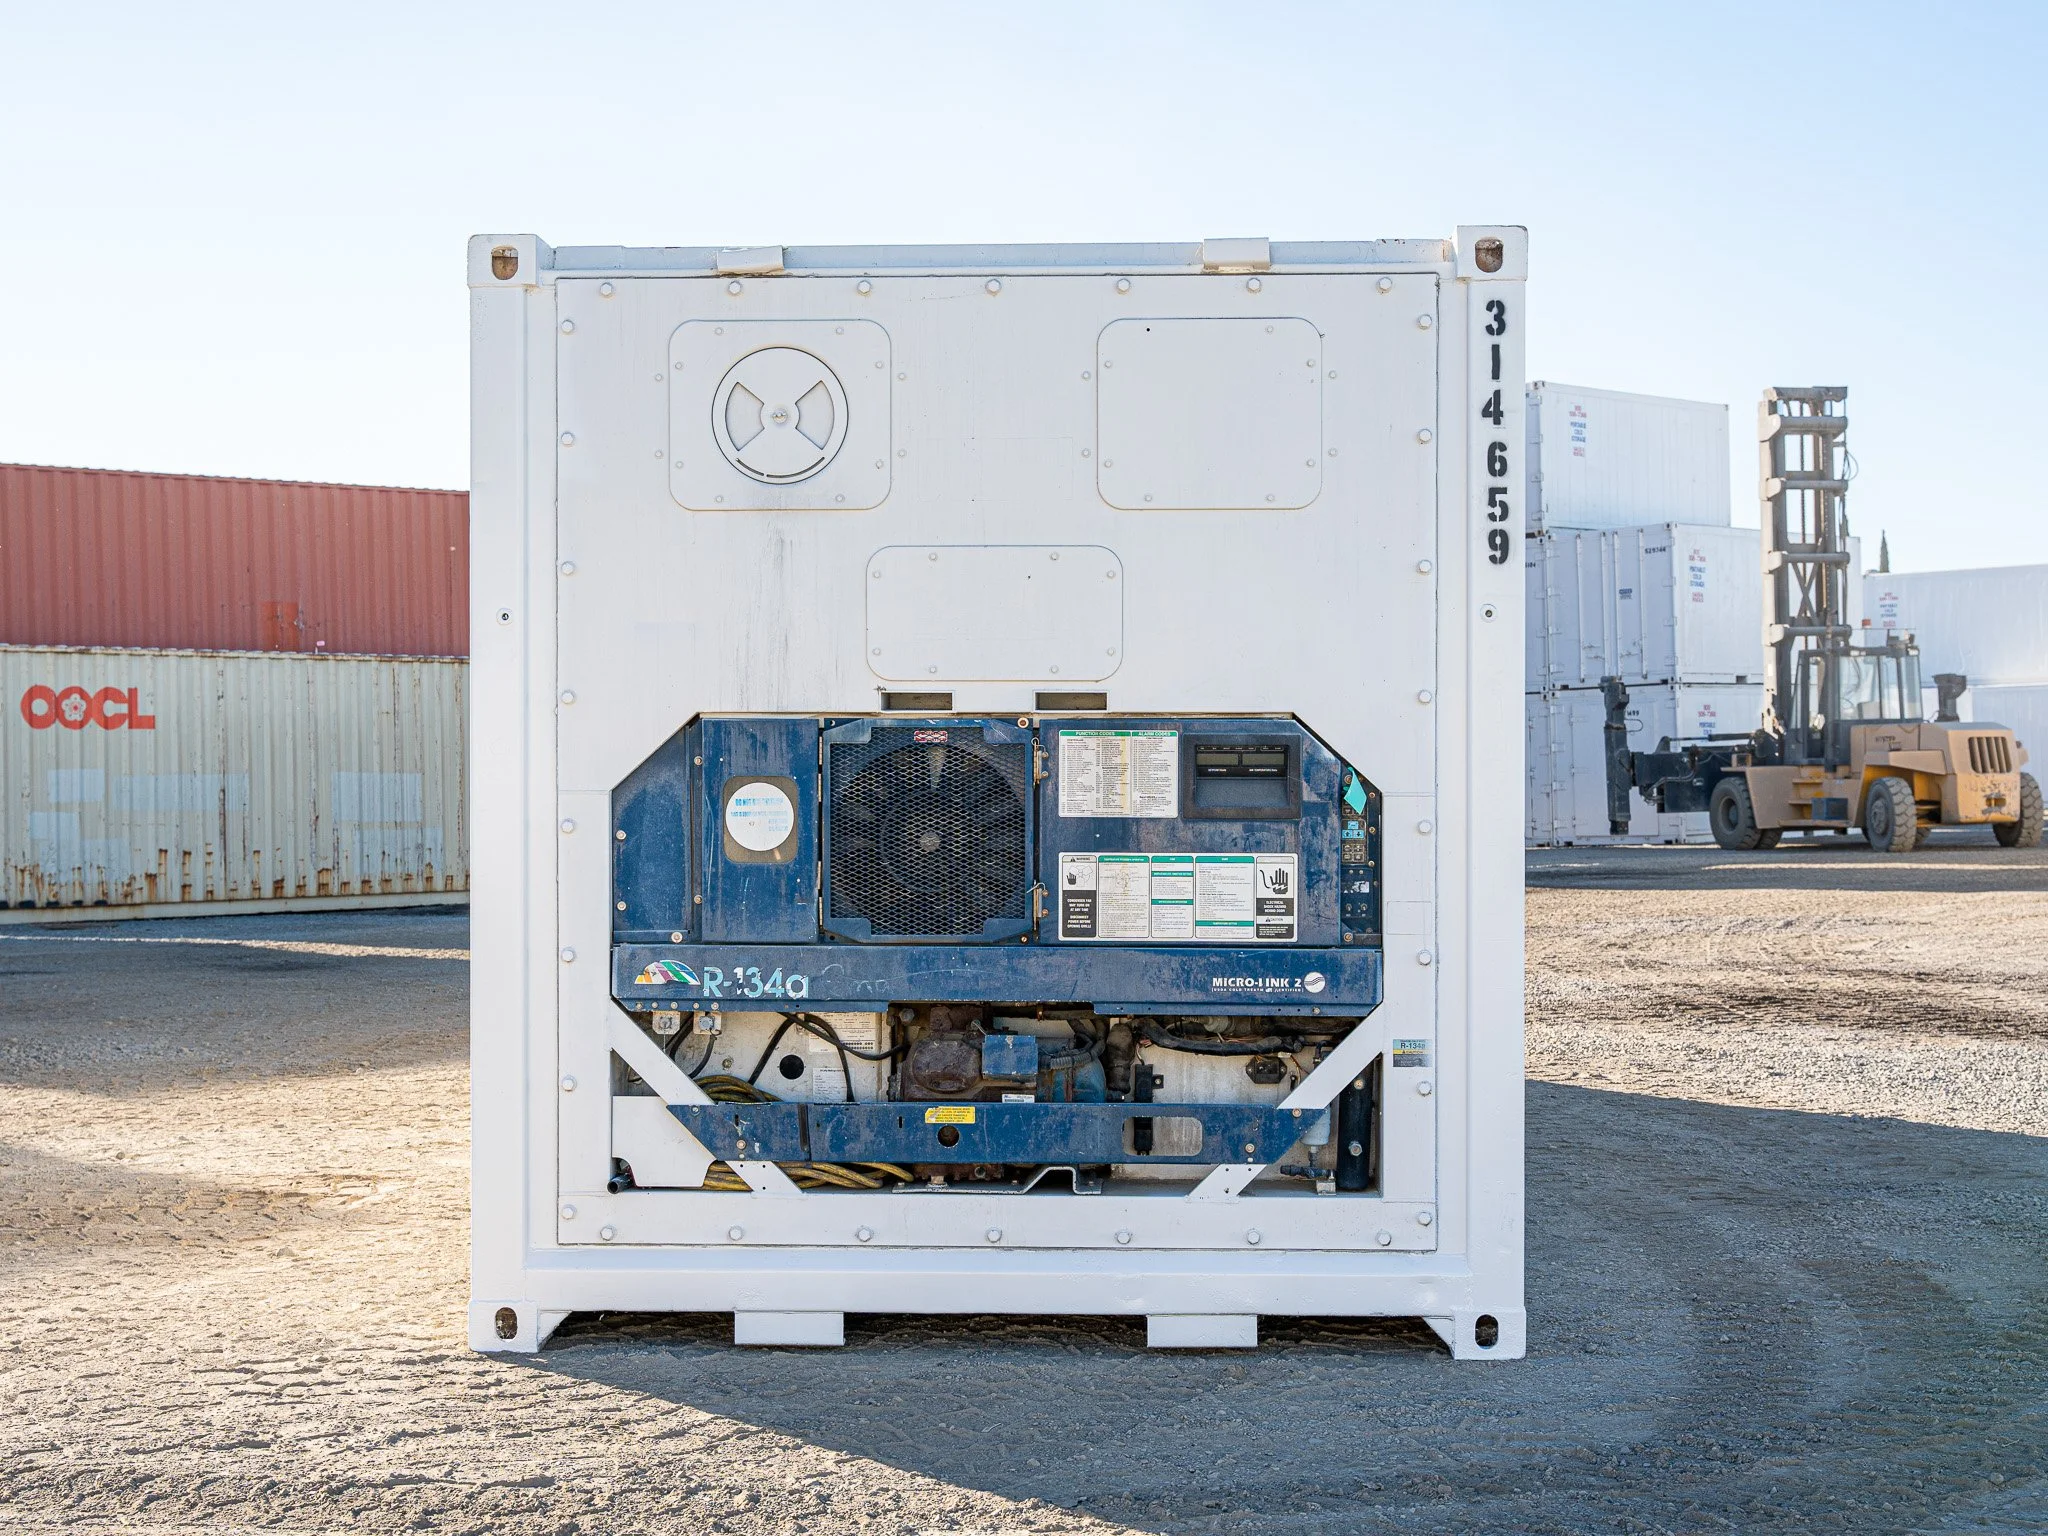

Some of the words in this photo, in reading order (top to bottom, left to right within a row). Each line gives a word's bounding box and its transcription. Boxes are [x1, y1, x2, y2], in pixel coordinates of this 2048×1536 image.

[1481, 299, 1510, 565] 314659
[20, 685, 156, 730] OOCL
[1294, 978, 1302, 987] 2
